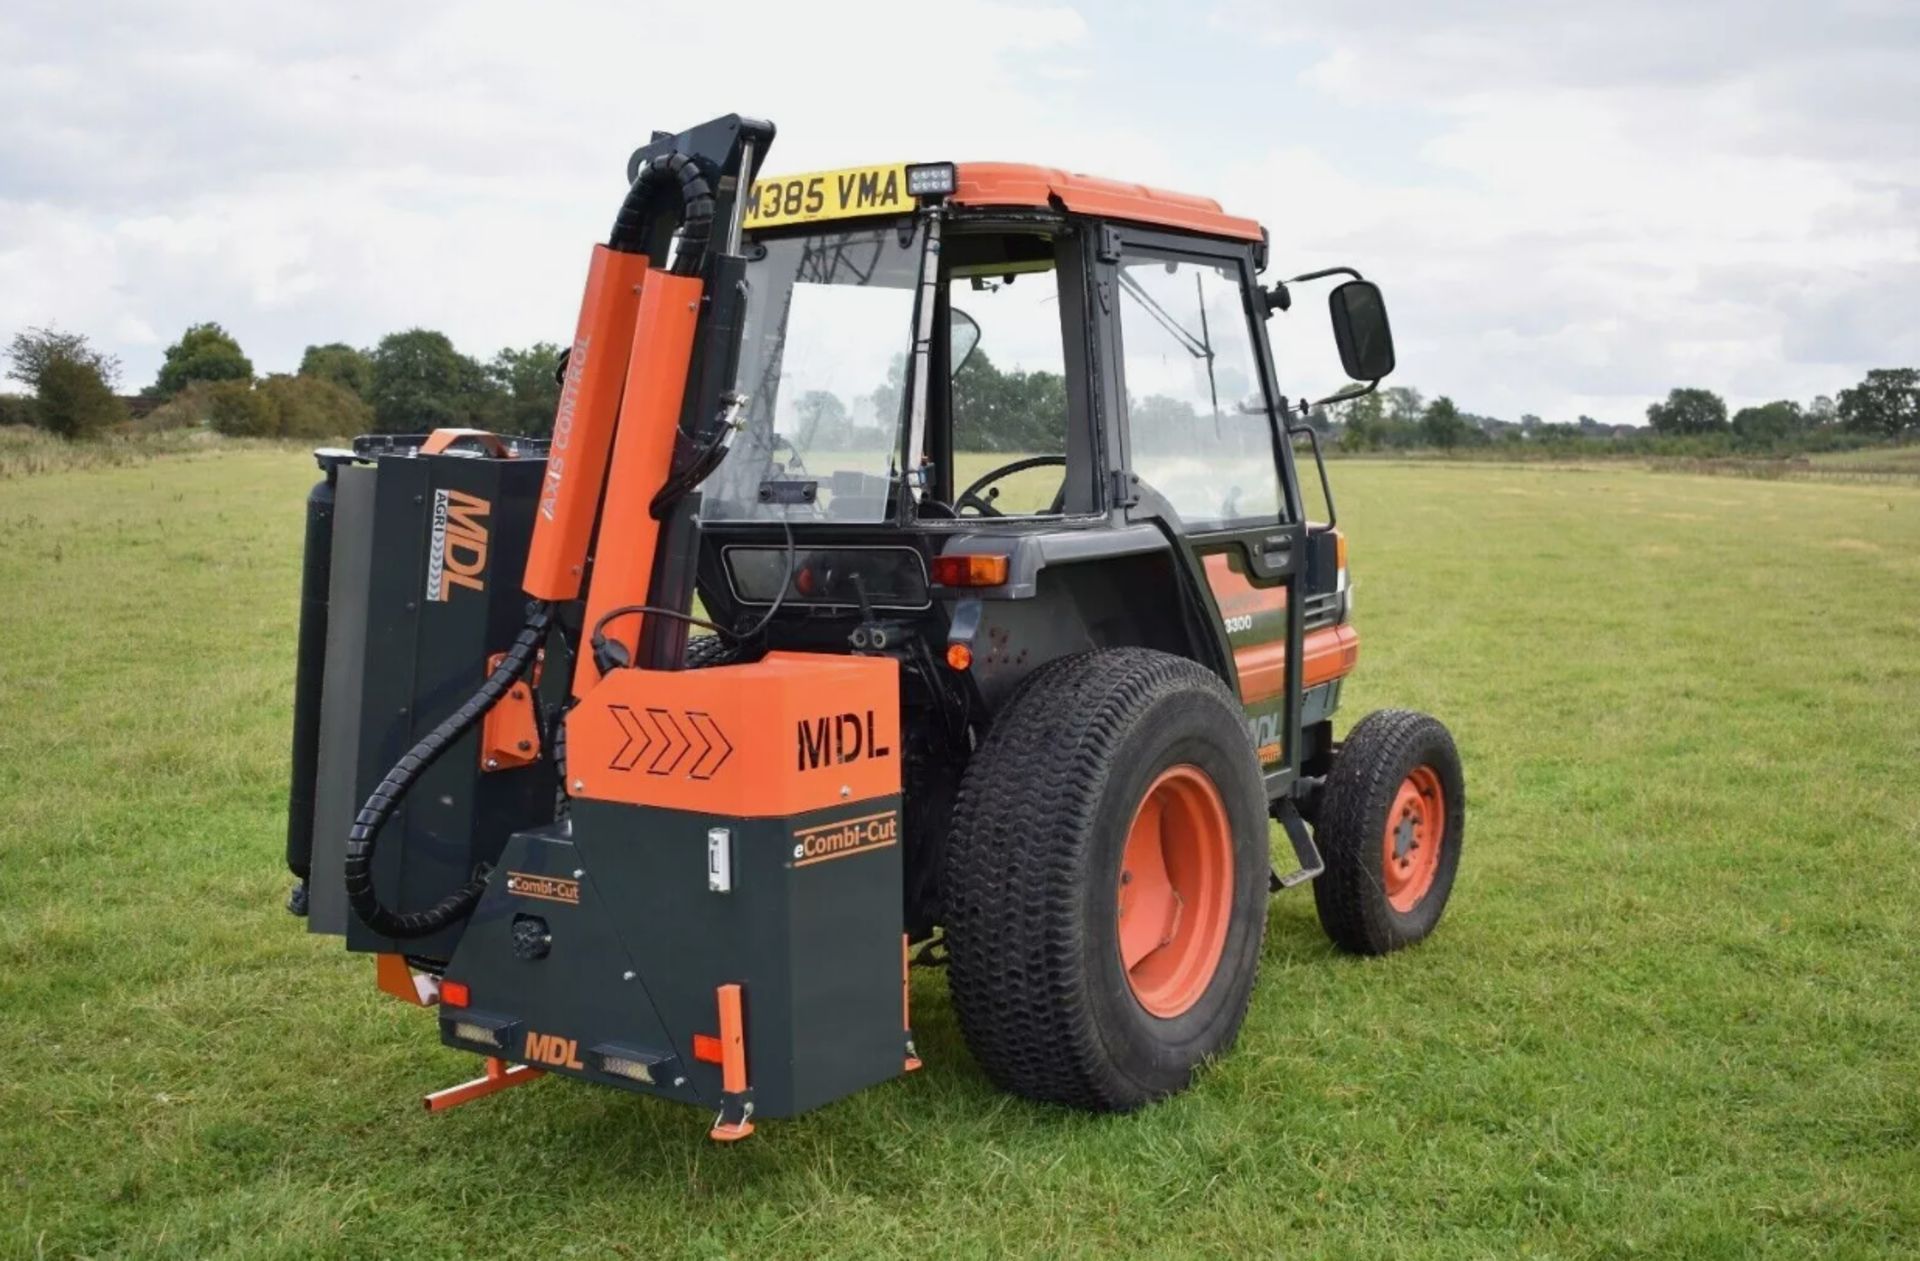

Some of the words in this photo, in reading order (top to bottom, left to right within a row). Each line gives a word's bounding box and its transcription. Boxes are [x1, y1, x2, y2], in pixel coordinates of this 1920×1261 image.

[744, 177, 825, 220] M385
[838, 170, 899, 210] VMA
[541, 456, 564, 521] AXIS
[556, 336, 591, 450] CONTROL
[434, 491, 447, 532] AGRI
[441, 489, 491, 602] MDL
[798, 710, 890, 772] MDL
[793, 818, 897, 858] eCombi-Cut
[507, 877, 579, 899] eCombi-Cut
[524, 1031, 584, 1070] MDL
